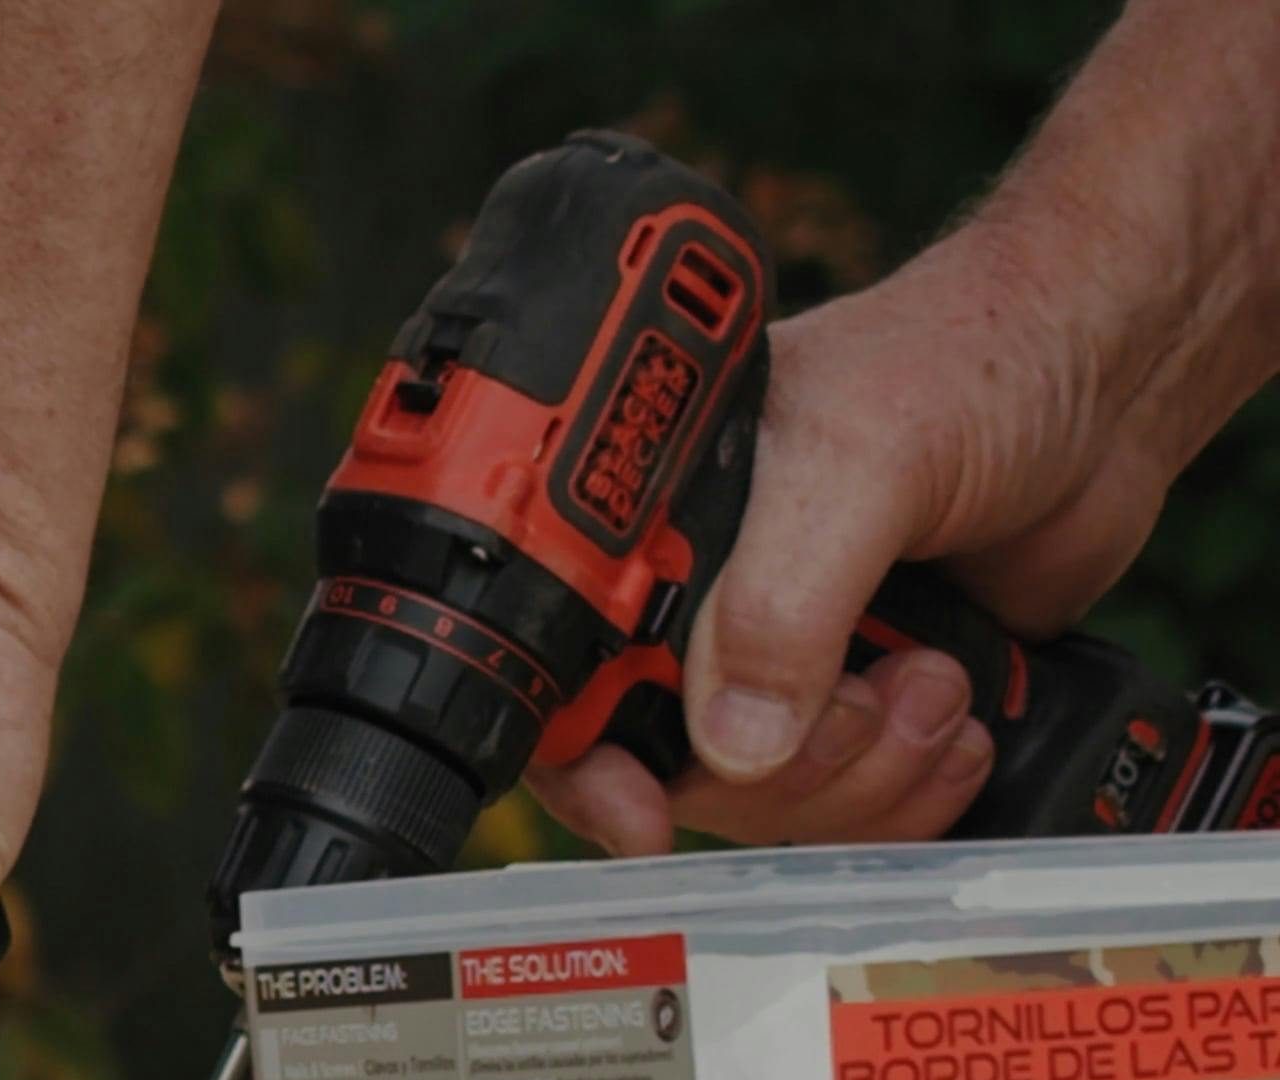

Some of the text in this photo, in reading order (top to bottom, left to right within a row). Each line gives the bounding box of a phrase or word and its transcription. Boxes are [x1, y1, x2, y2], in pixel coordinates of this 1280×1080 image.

[257, 962, 409, 1000] THE PROBLEM:
[462, 947, 629, 987] THE SOLUTION:
[281, 1025, 317, 1046] FACE
[465, 1001, 644, 1036] EDGE FASTENING
[871, 995, 1173, 1053] TORNILLOS
[1129, 1034, 1237, 1080] LAS
[1247, 1029, 1280, 1071] T
